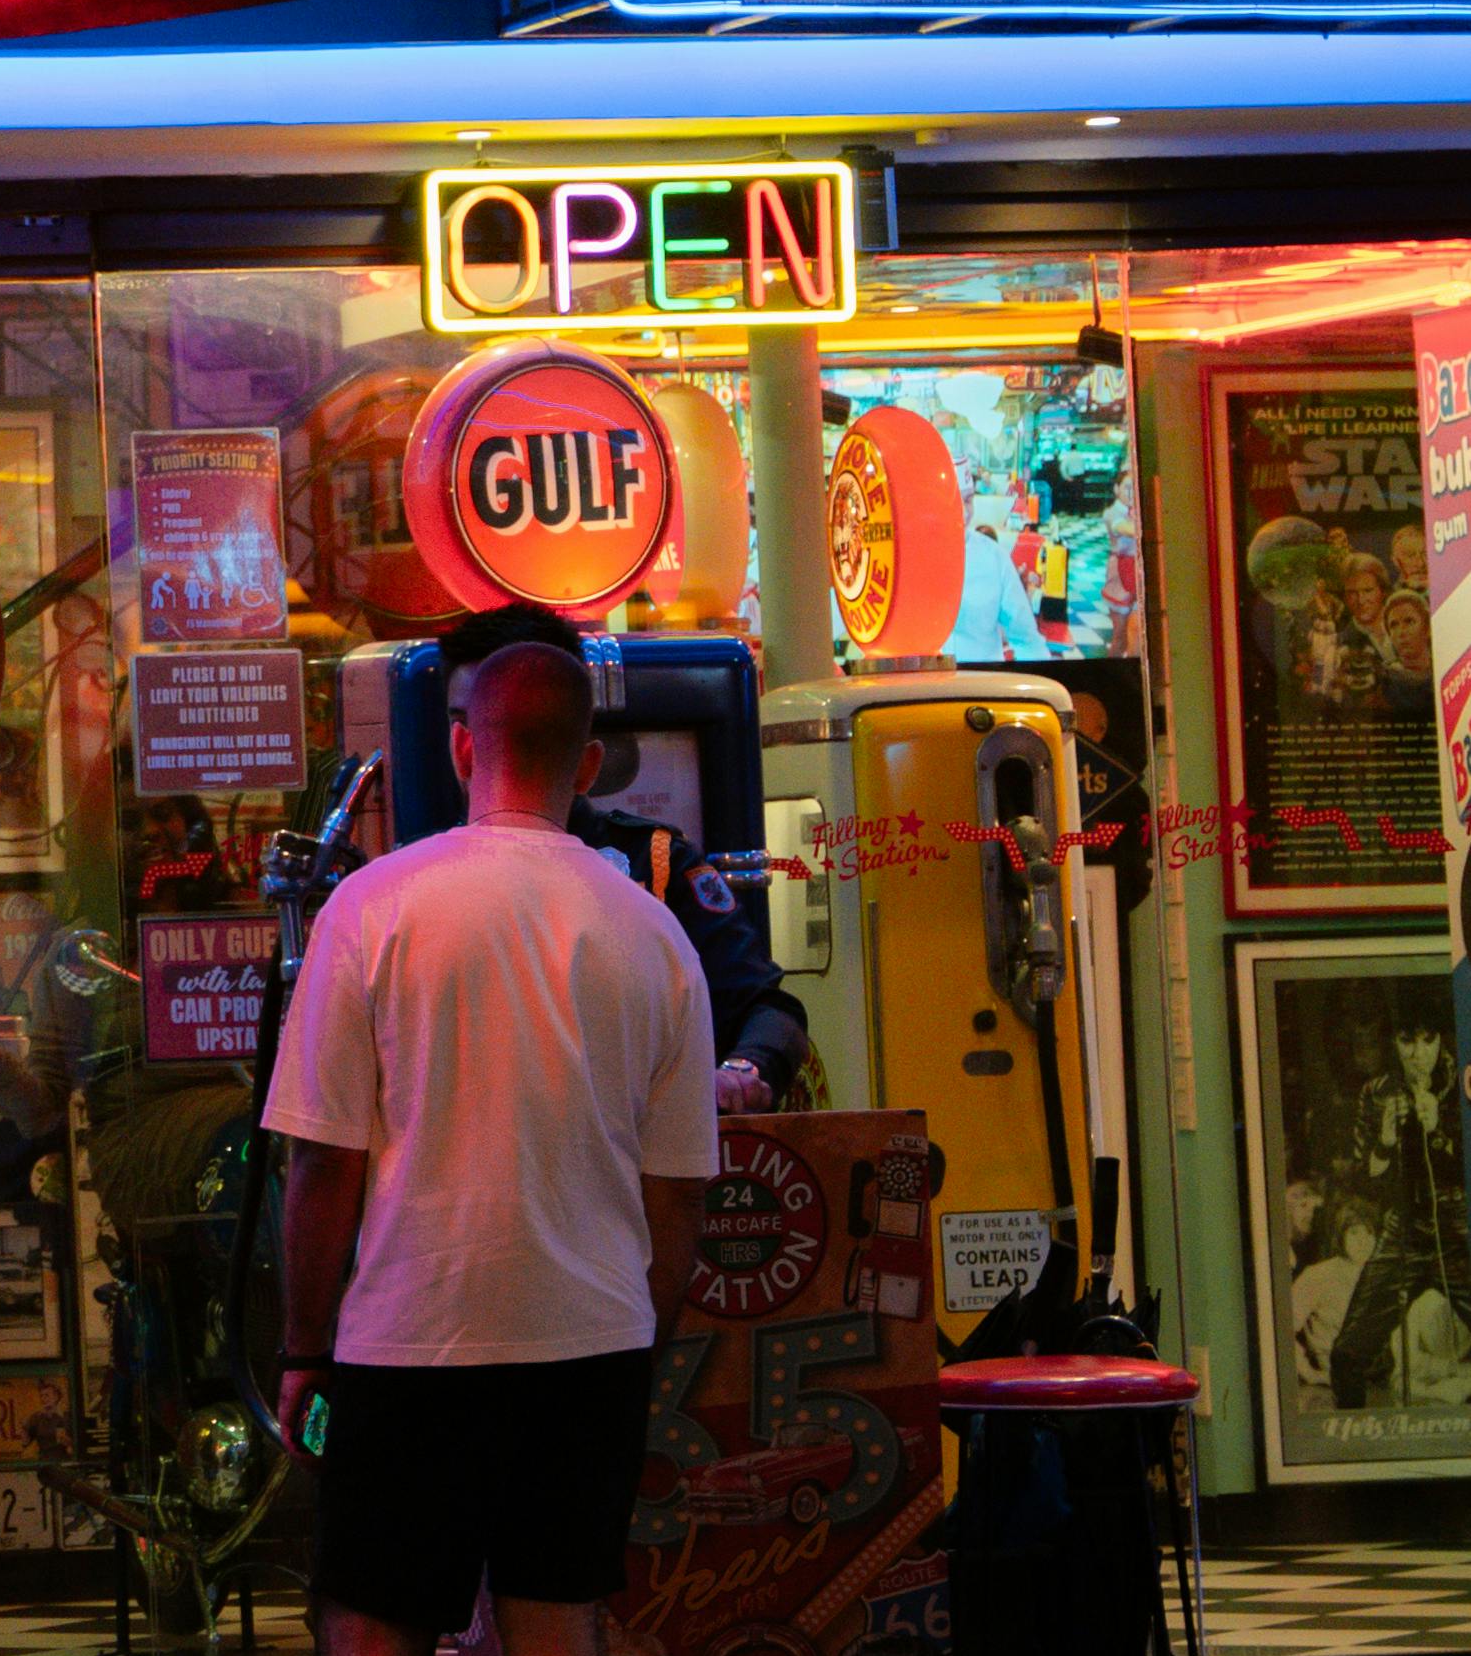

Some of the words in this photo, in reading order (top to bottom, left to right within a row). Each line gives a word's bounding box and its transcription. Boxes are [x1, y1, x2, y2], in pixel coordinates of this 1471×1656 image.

[448, 178, 835, 314] OPEN
[1252, 408, 1292, 422] ALL
[1303, 407, 1357, 421] NEED
[1362, 405, 1387, 420] TO
[152, 452, 206, 473] PRIORITY
[207, 452, 258, 472] SEATING
[468, 427, 647, 537] GULF
[1432, 511, 1468, 552] gum
[171, 666, 216, 684] PLEASE
[218, 665, 236, 683] DO
[239, 664, 264, 682] NOT
[149, 687, 184, 706] LEAVE
[186, 686, 219, 704] YOUR
[221, 684, 289, 703] VALUABLES
[178, 705, 260, 725] UNATTENDED
[811, 814, 891, 858] Filling
[841, 840, 950, 883] Station
[148, 927, 217, 963] ONLY
[177, 965, 238, 994] with
[169, 997, 212, 1025] CAN
[721, 1185, 755, 1210] 24
[958, 1218, 980, 1230] FOR
[983, 1217, 1004, 1230] USE
[1007, 1216, 1021, 1228] AS
[949, 1233, 986, 1245] MOTOR
[989, 1232, 1014, 1243] FUEL
[1017, 1230, 1044, 1242] ONLY
[719, 1241, 763, 1264] HRS
[954, 1247, 1042, 1267] CONTAINS
[969, 1267, 1030, 1289] LEAD
[625, 1516, 834, 1636] Years
[876, 1564, 940, 1593] ROUTE
